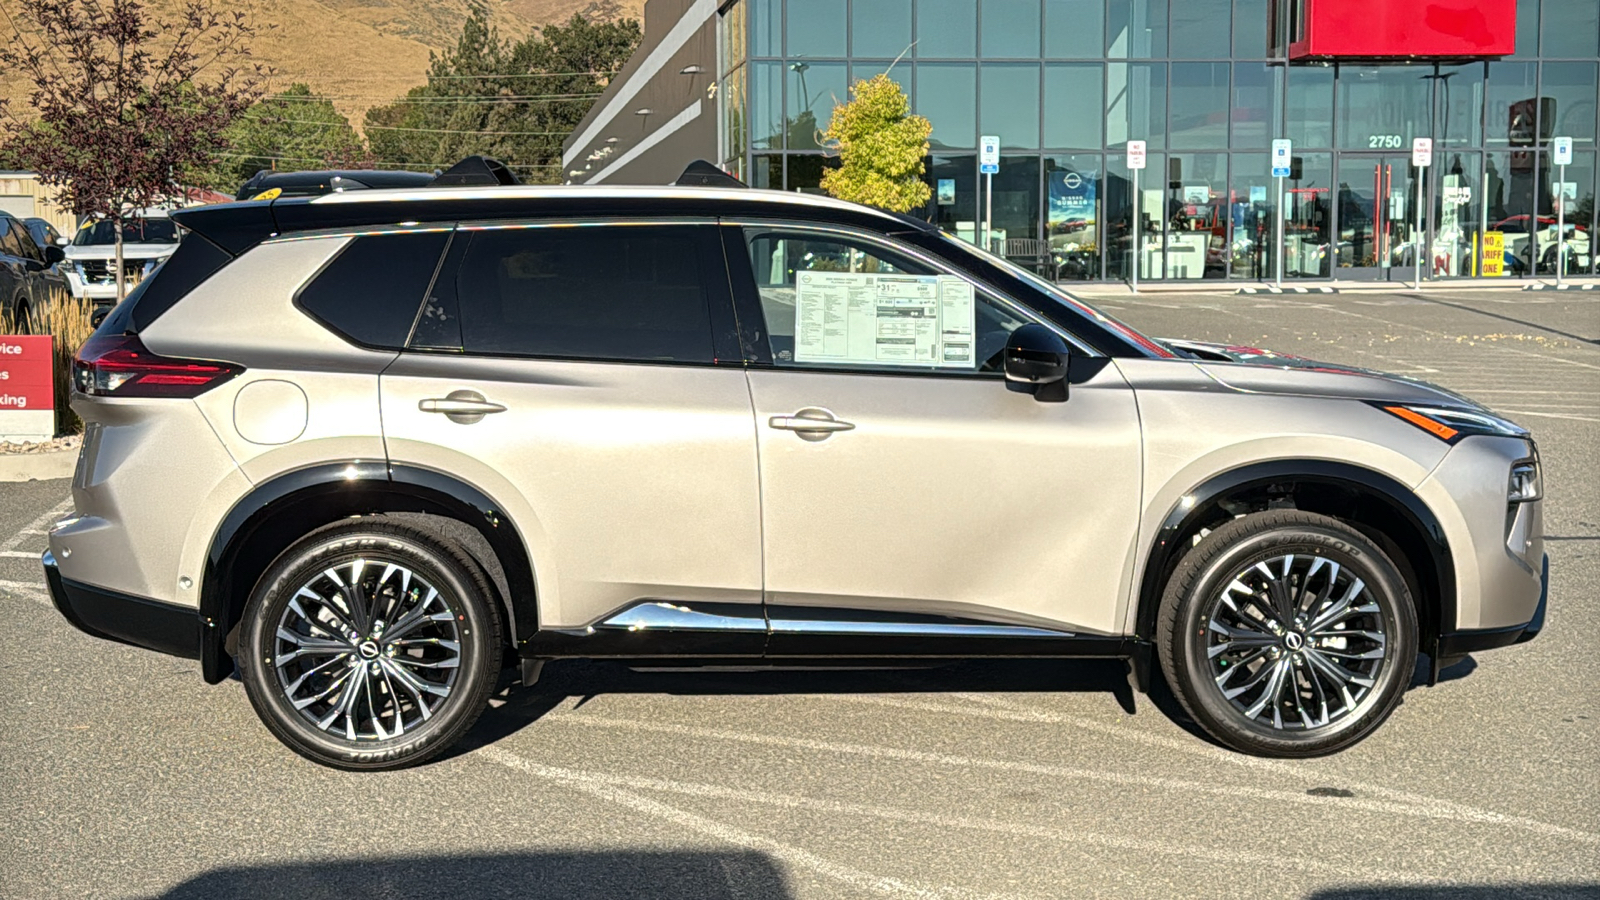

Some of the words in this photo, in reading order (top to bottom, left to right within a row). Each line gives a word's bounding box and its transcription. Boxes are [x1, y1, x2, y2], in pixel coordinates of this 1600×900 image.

[1369, 135, 1402, 148] 2750
[1485, 236, 1494, 246] NO
[1482, 250, 1502, 260] RIFF
[1483, 264, 1498, 274] ONE
[881, 284, 890, 292] 31
[0, 342, 22, 355] ice
[1281, 534, 1360, 556] DUNLOP
[341, 736, 429, 762] DUNLOP
